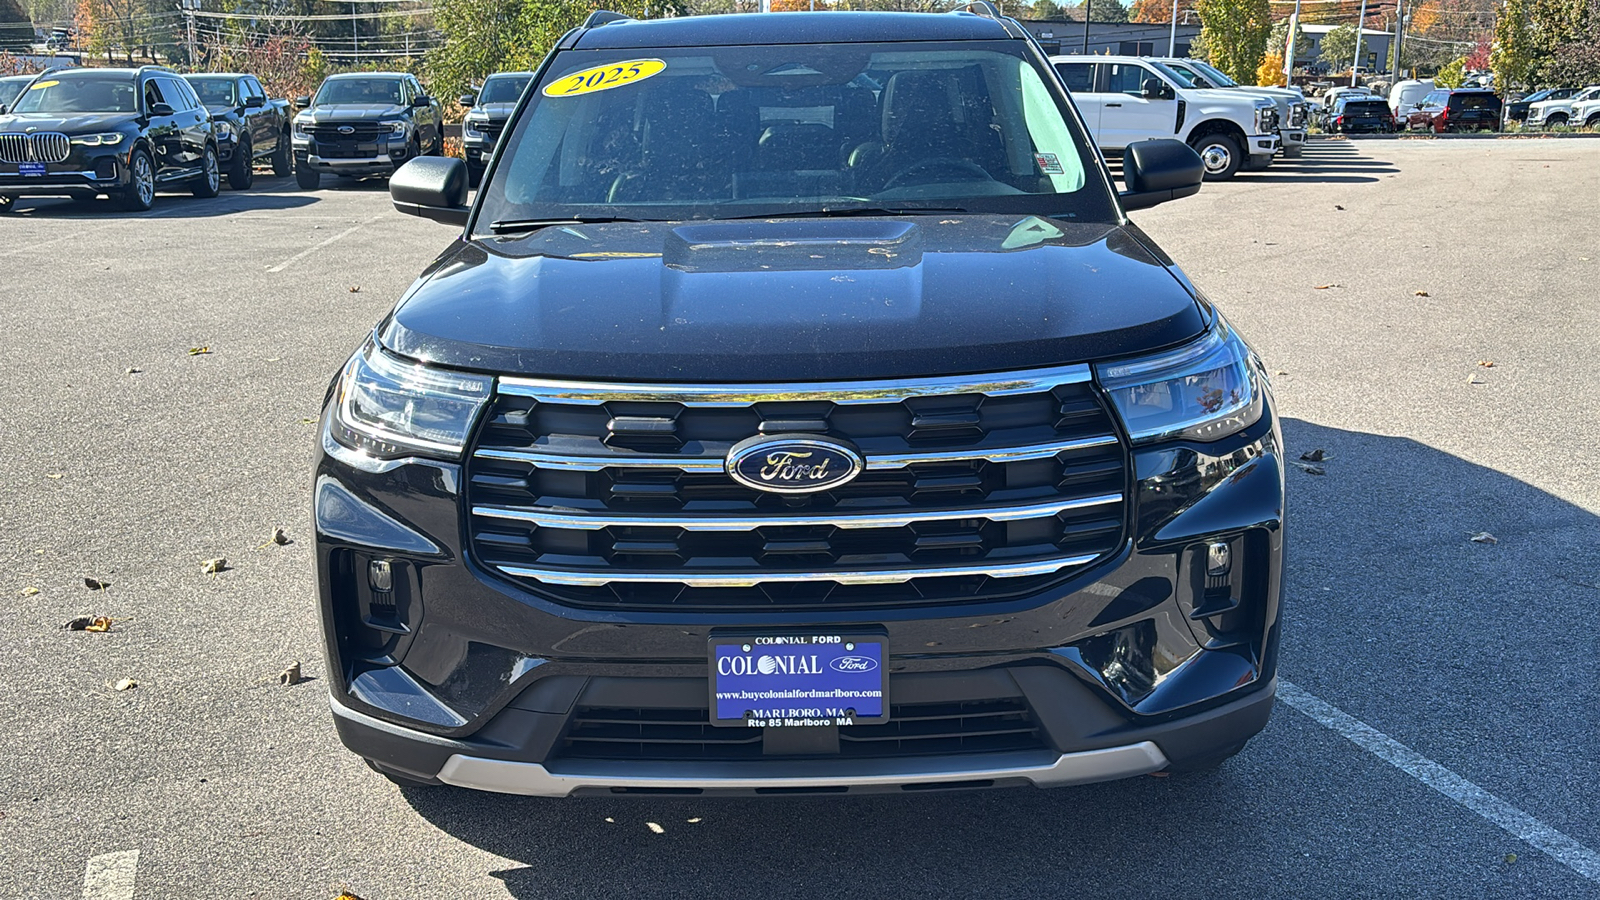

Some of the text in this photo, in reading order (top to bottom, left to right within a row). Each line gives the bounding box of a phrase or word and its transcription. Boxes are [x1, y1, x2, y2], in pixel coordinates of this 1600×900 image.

[564, 63, 644, 93] 2025
[760, 451, 831, 481] Ford
[755, 636, 841, 645] COLONIAL FORD
[717, 655, 823, 676] COLONIAL
[838, 658, 868, 670] Ford
[716, 689, 882, 701] www.buycolonialfordmarlboro.com
[826, 708, 845, 718] MA
[748, 718, 853, 728] Rte 85 Marlboro MA
